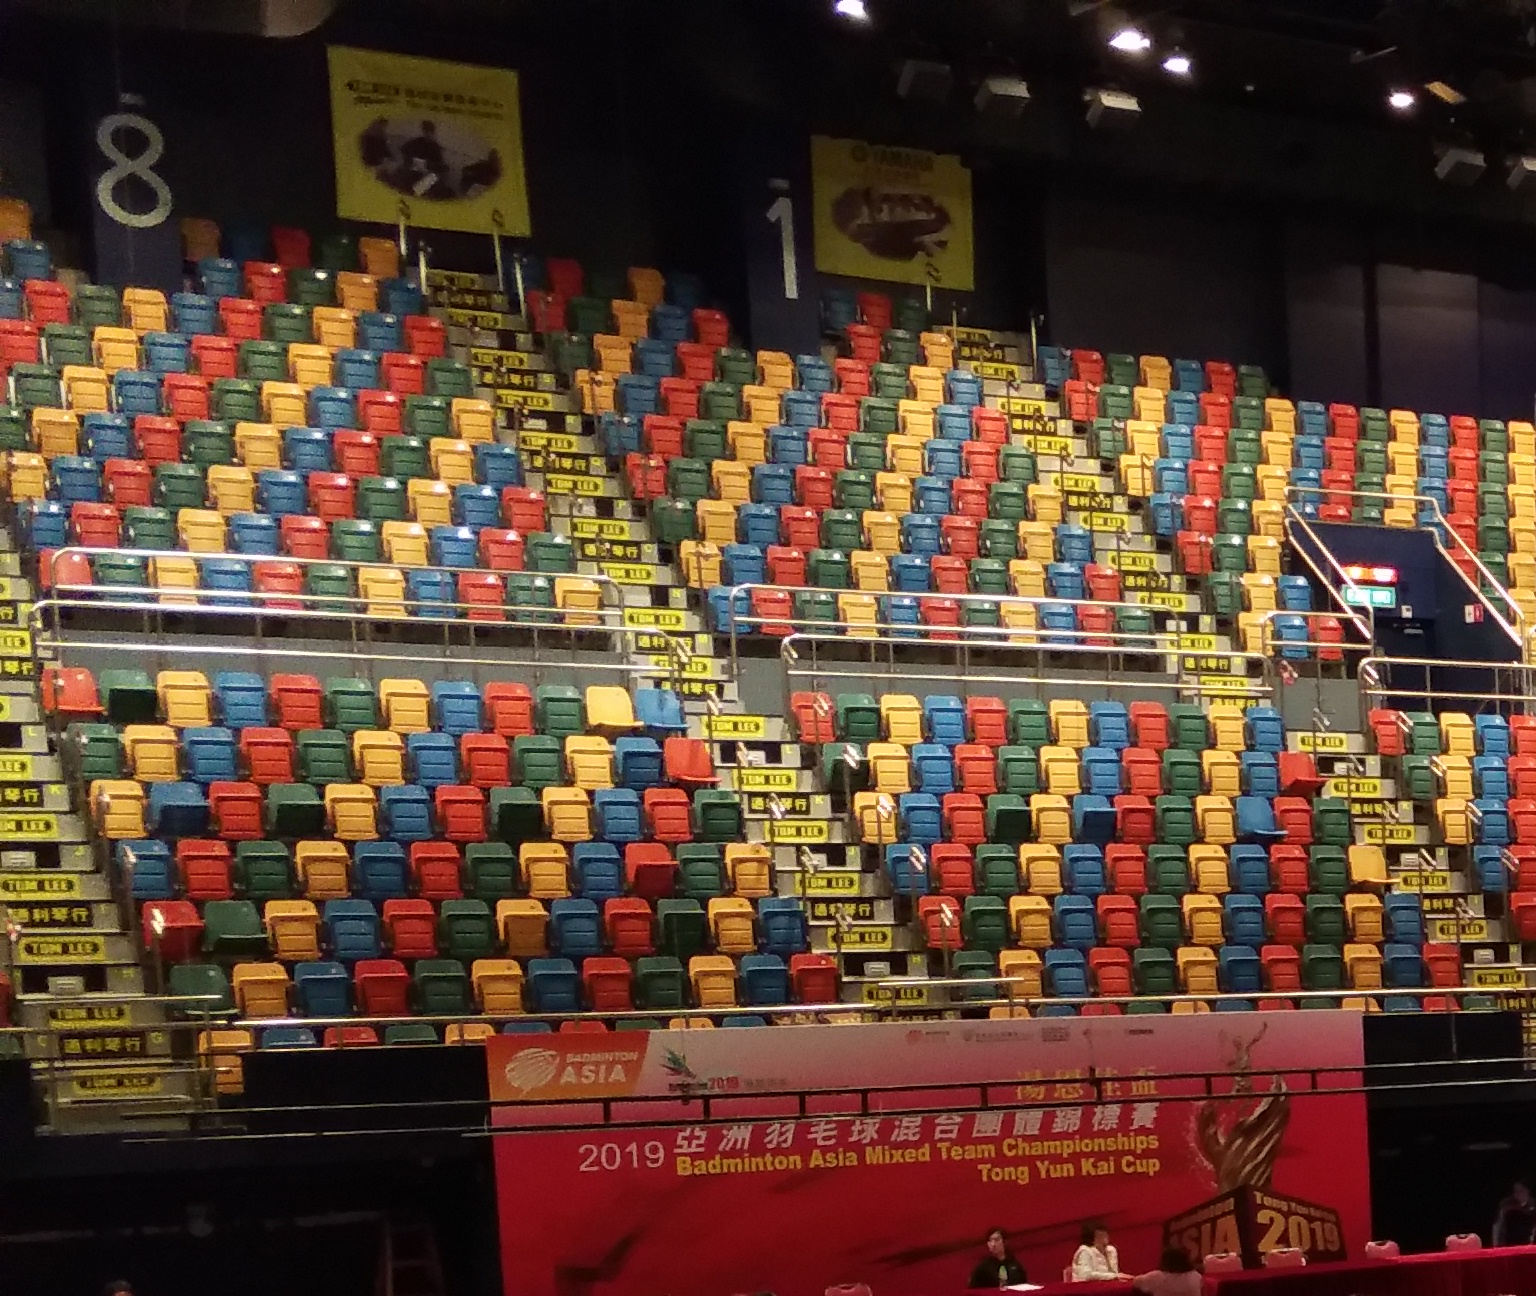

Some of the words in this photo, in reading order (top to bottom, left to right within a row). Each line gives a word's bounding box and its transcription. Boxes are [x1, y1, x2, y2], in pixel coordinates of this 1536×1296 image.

[96, 113, 172, 229] 8
[766, 197, 799, 299] 1
[42, 880, 70, 893] LEE
[31, 942, 65, 956] TOM
[68, 942, 98, 955] LEE
[560, 1064, 627, 1085] ASIA
[566, 1051, 638, 1063] BADMINTON
[579, 1141, 665, 1173] 2019
[674, 1101, 1160, 1154] 亞洲羽毛球混合團體錦標賽
[676, 1151, 802, 1176] Badminton
[809, 1149, 858, 1169] Asia
[865, 1143, 931, 1166] Mixed
[937, 1140, 996, 1160] Team
[1002, 1132, 1159, 1158] Championships
[978, 1163, 1029, 1185] Tong
[1037, 1159, 1075, 1179] Yun
[1081, 1157, 1115, 1176] Kai
[1121, 1154, 1161, 1177] Cup
[1257, 1209, 1341, 1253] 2019
